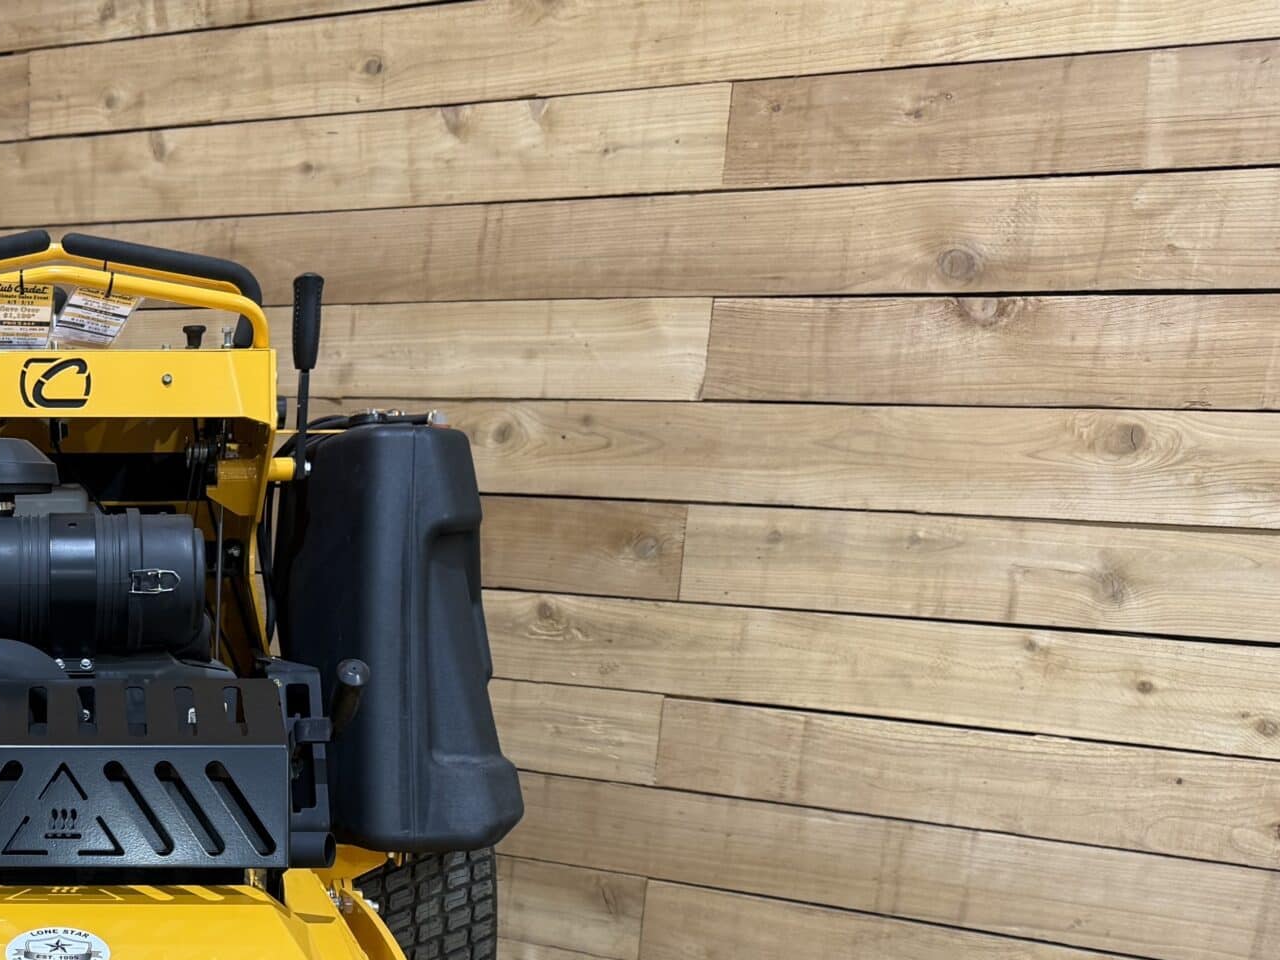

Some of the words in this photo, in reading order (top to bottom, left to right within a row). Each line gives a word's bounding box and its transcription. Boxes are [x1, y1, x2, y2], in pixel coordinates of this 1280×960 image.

[14, 284, 49, 295] Cadet
[30, 928, 59, 937] LONE
[62, 928, 90, 939] STAR
[35, 953, 55, 960] EST.
